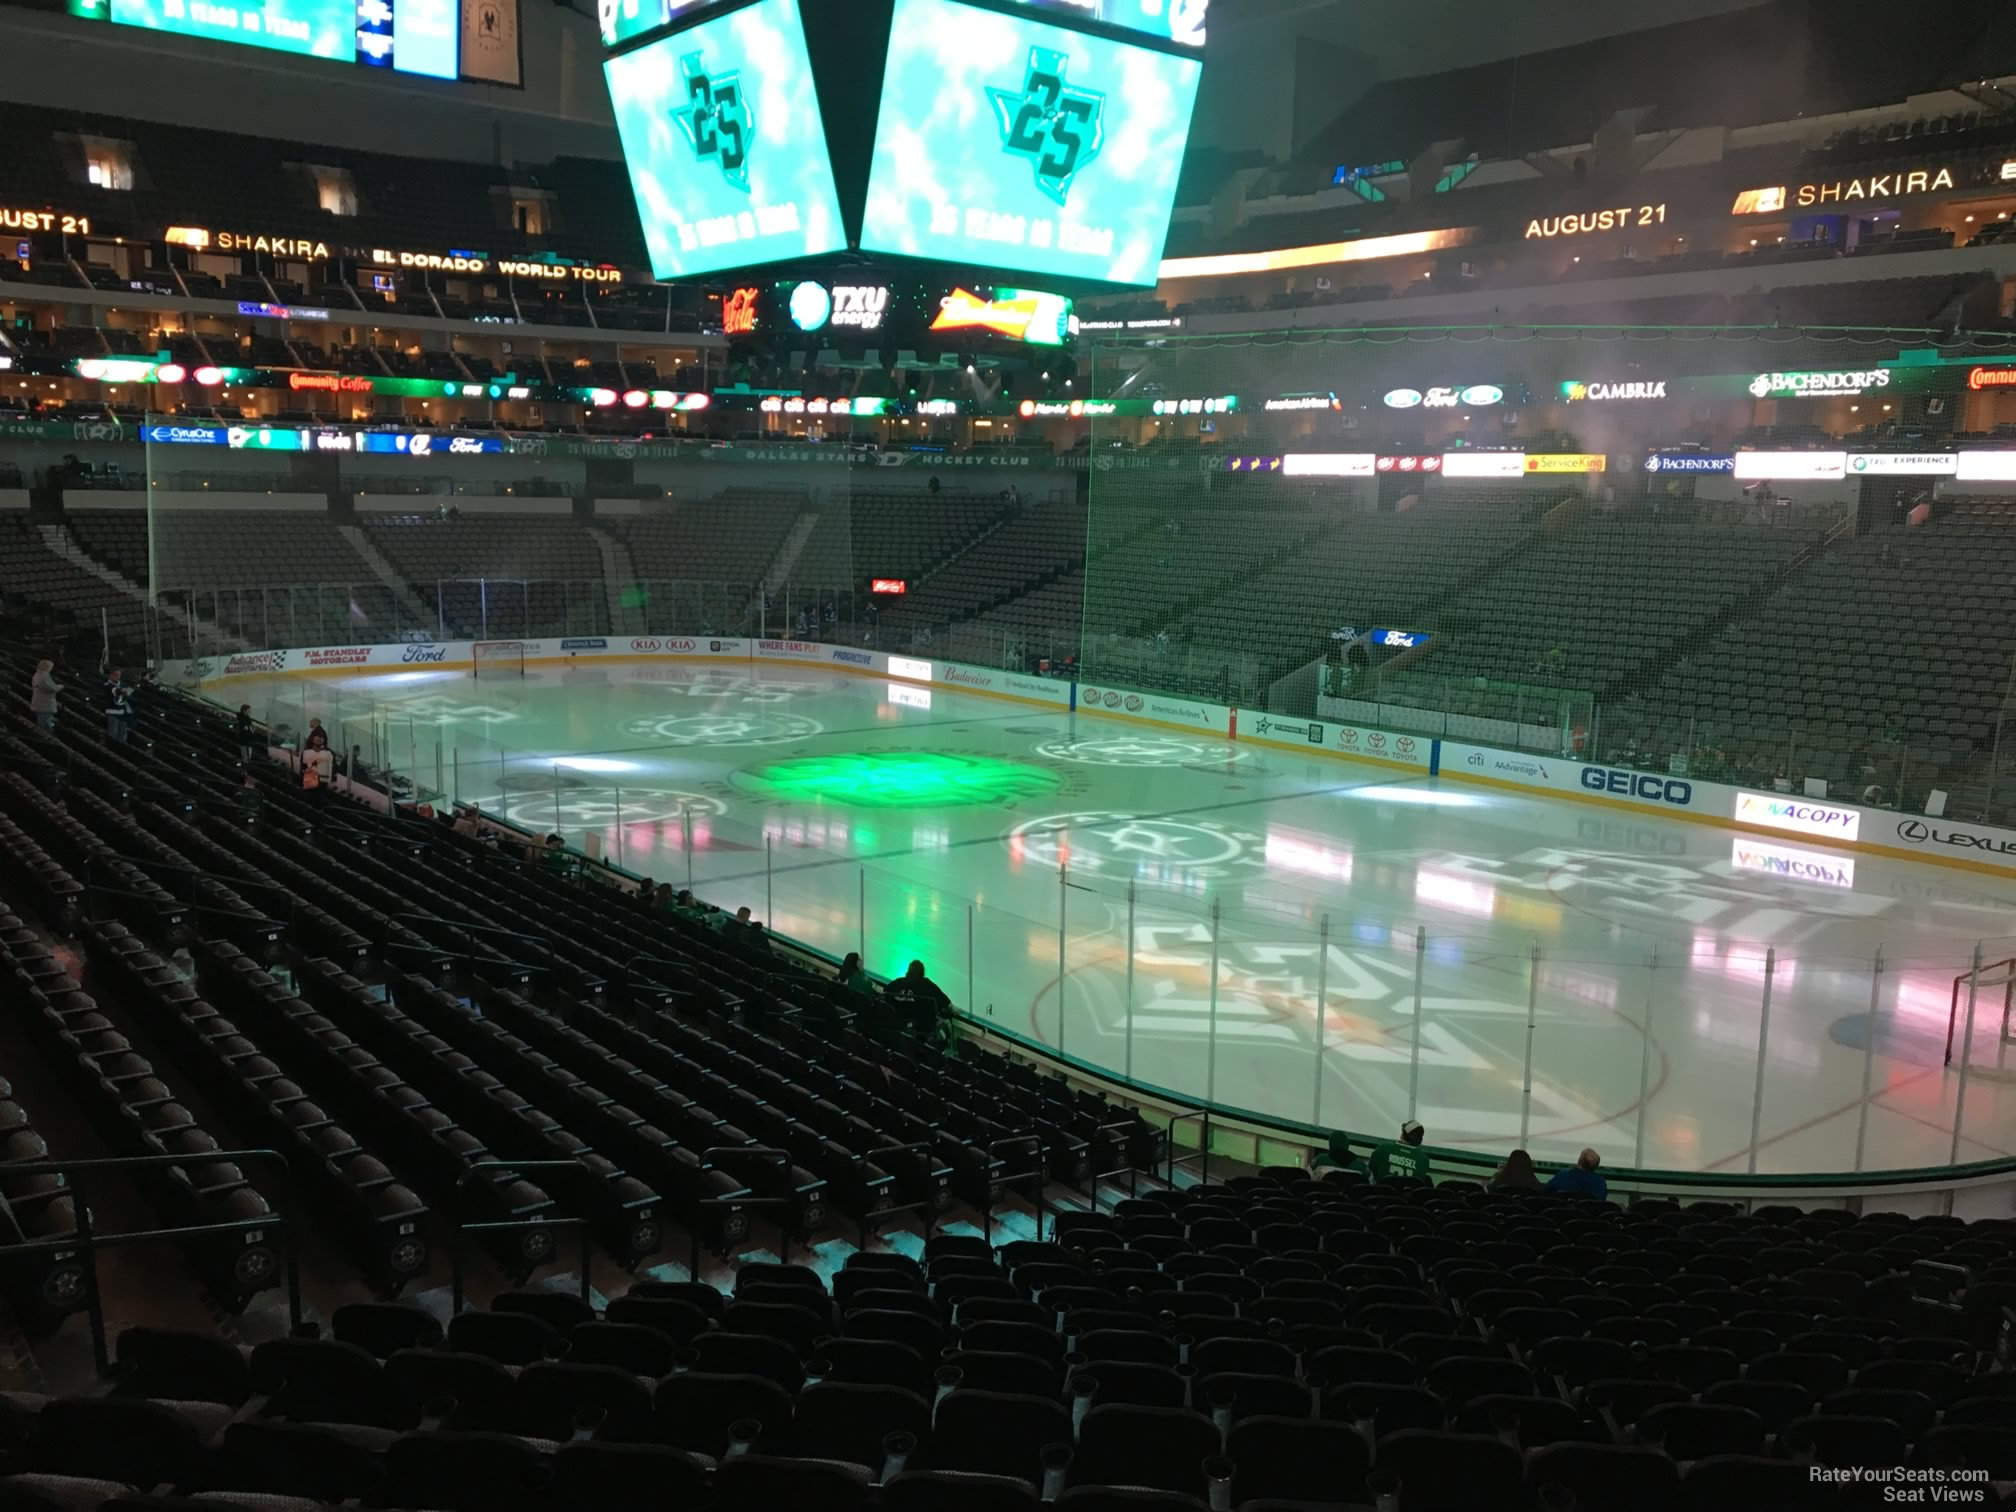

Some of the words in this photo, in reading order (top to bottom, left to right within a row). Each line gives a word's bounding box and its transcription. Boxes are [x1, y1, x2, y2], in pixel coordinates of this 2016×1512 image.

[1797, 168, 1954, 206] SHAKIRA
[0, 208, 54, 232] UST
[62, 216, 89, 234] 21
[1525, 207, 1632, 239] AUGUST
[1638, 203, 1666, 225] 21
[218, 232, 329, 258] SHAKIRA
[373, 249, 395, 264] EL
[400, 252, 484, 273] DORADO
[498, 260, 567, 278] WORLD
[571, 266, 621, 283] TOUR
[832, 286, 887, 312] TXU
[831, 311, 881, 329] energy
[290, 373, 340, 390] Community
[340, 376, 373, 392] Coffee
[1771, 368, 1890, 390] BACHENDORF'S
[1423, 387, 1460, 407] Ford
[1587, 381, 1666, 400] CAMBRIA
[9, 425, 44, 434] CLUB
[170, 427, 215, 440] CyrusOne
[448, 437, 483, 454] Ford
[746, 450, 809, 461] DALLAS
[816, 451, 867, 462] STARS
[922, 454, 984, 465] HOCKEY
[990, 456, 1031, 466] CLUB
[1662, 457, 1735, 471] BACHENDORF'S
[1894, 457, 1950, 465] EXPERIENCE
[635, 641, 656, 649] KIA
[670, 641, 692, 649] KIA
[758, 640, 785, 651] WHERE
[785, 641, 803, 652] FANS
[1384, 631, 1414, 647] Ford
[310, 656, 367, 665] MOTORCARS
[402, 644, 446, 663] Ford
[832, 650, 872, 665] PROGRESSIVE
[943, 665, 992, 686] Budweiser
[1151, 704, 1178, 718] American
[1178, 708, 1201, 720] Airlines
[1337, 743, 1361, 752] TOYOTA
[1364, 747, 1389, 757] TOYOTA
[1392, 751, 1418, 761] TOYOTA
[1467, 752, 1484, 767] citi
[1494, 760, 1538, 776] AAdvantage
[1580, 766, 1692, 805] GEICO
[1388, 1153, 1417, 1170] ROUSSEL
